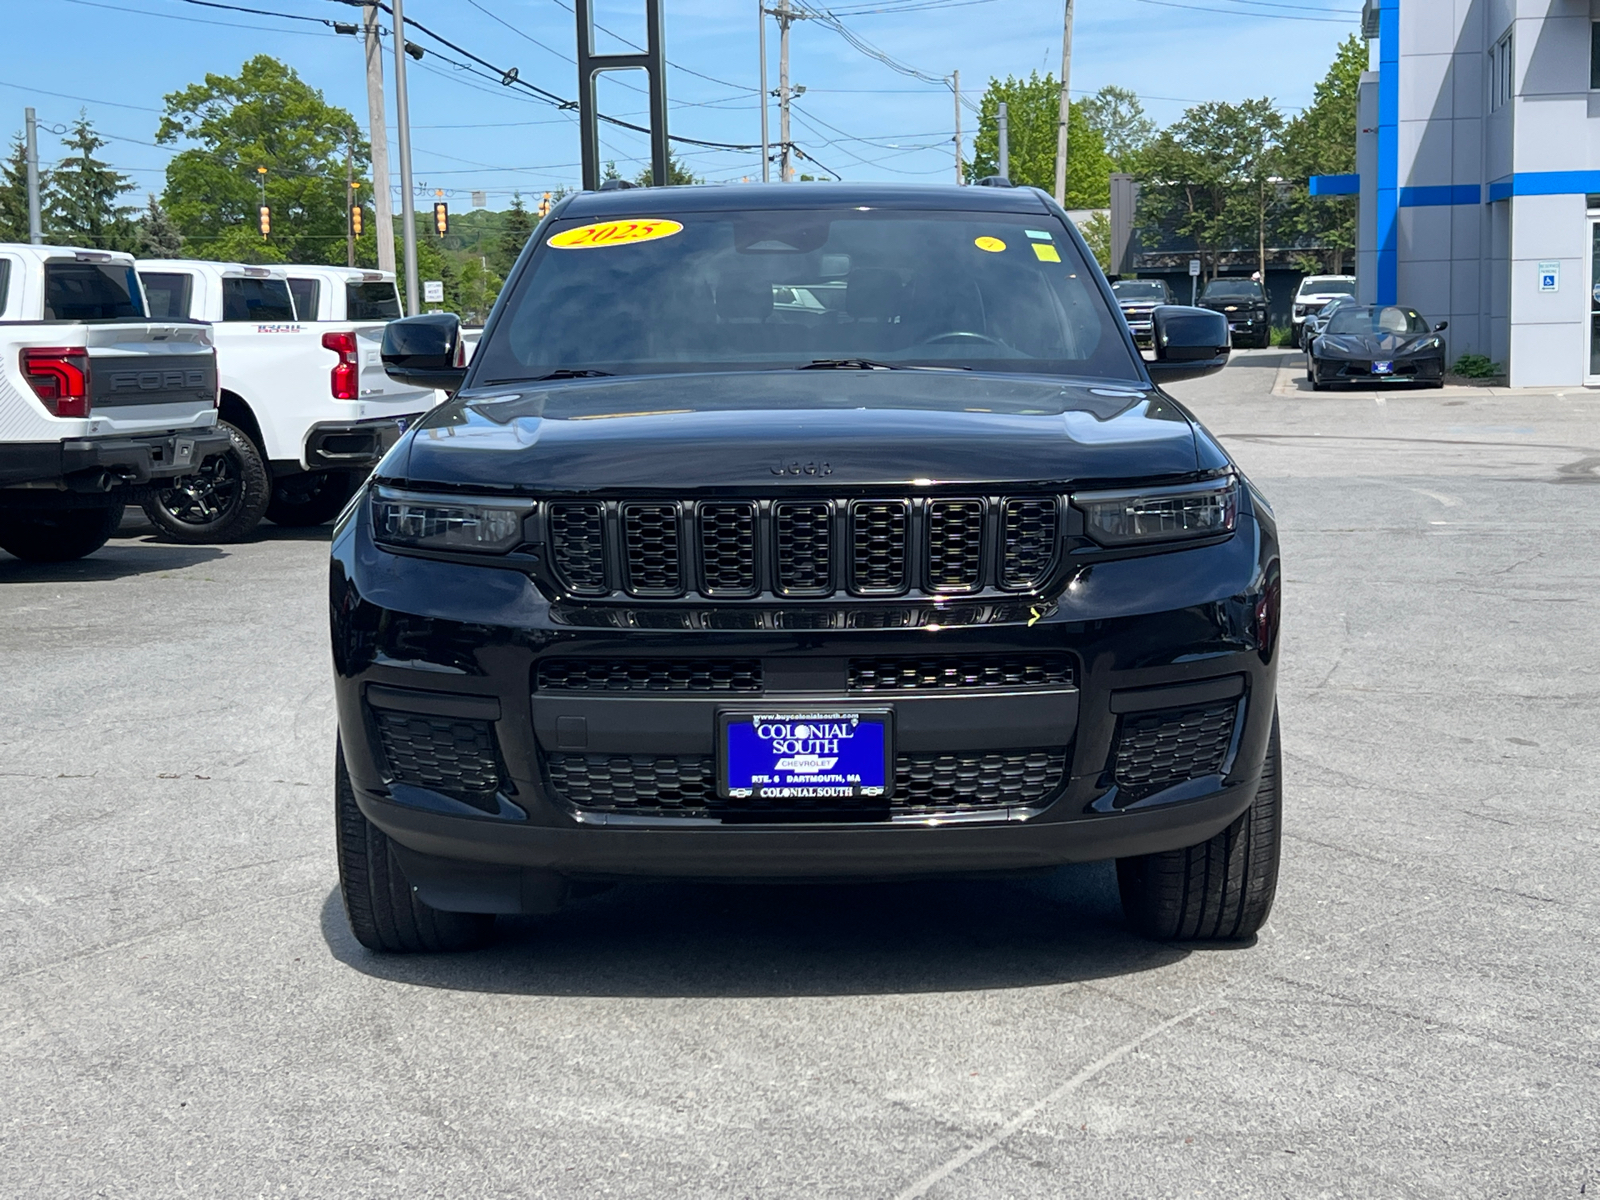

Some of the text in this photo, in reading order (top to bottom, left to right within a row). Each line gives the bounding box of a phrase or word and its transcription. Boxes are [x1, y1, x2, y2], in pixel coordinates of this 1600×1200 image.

[566, 220, 663, 246] 2025
[109, 370, 206, 392] FORD
[769, 461, 833, 478] Jeep
[752, 713, 859, 721] www.buycolonialsouth.com
[757, 723, 854, 739] COLONIAL
[772, 739, 839, 754] SOUTH
[781, 759, 832, 768] CHEVROLET
[751, 775, 773, 783] RTE.
[786, 774, 846, 783] DARTMOUTH,
[846, 774, 861, 782] MA
[760, 787, 853, 798] COLONIAL SOUTH
